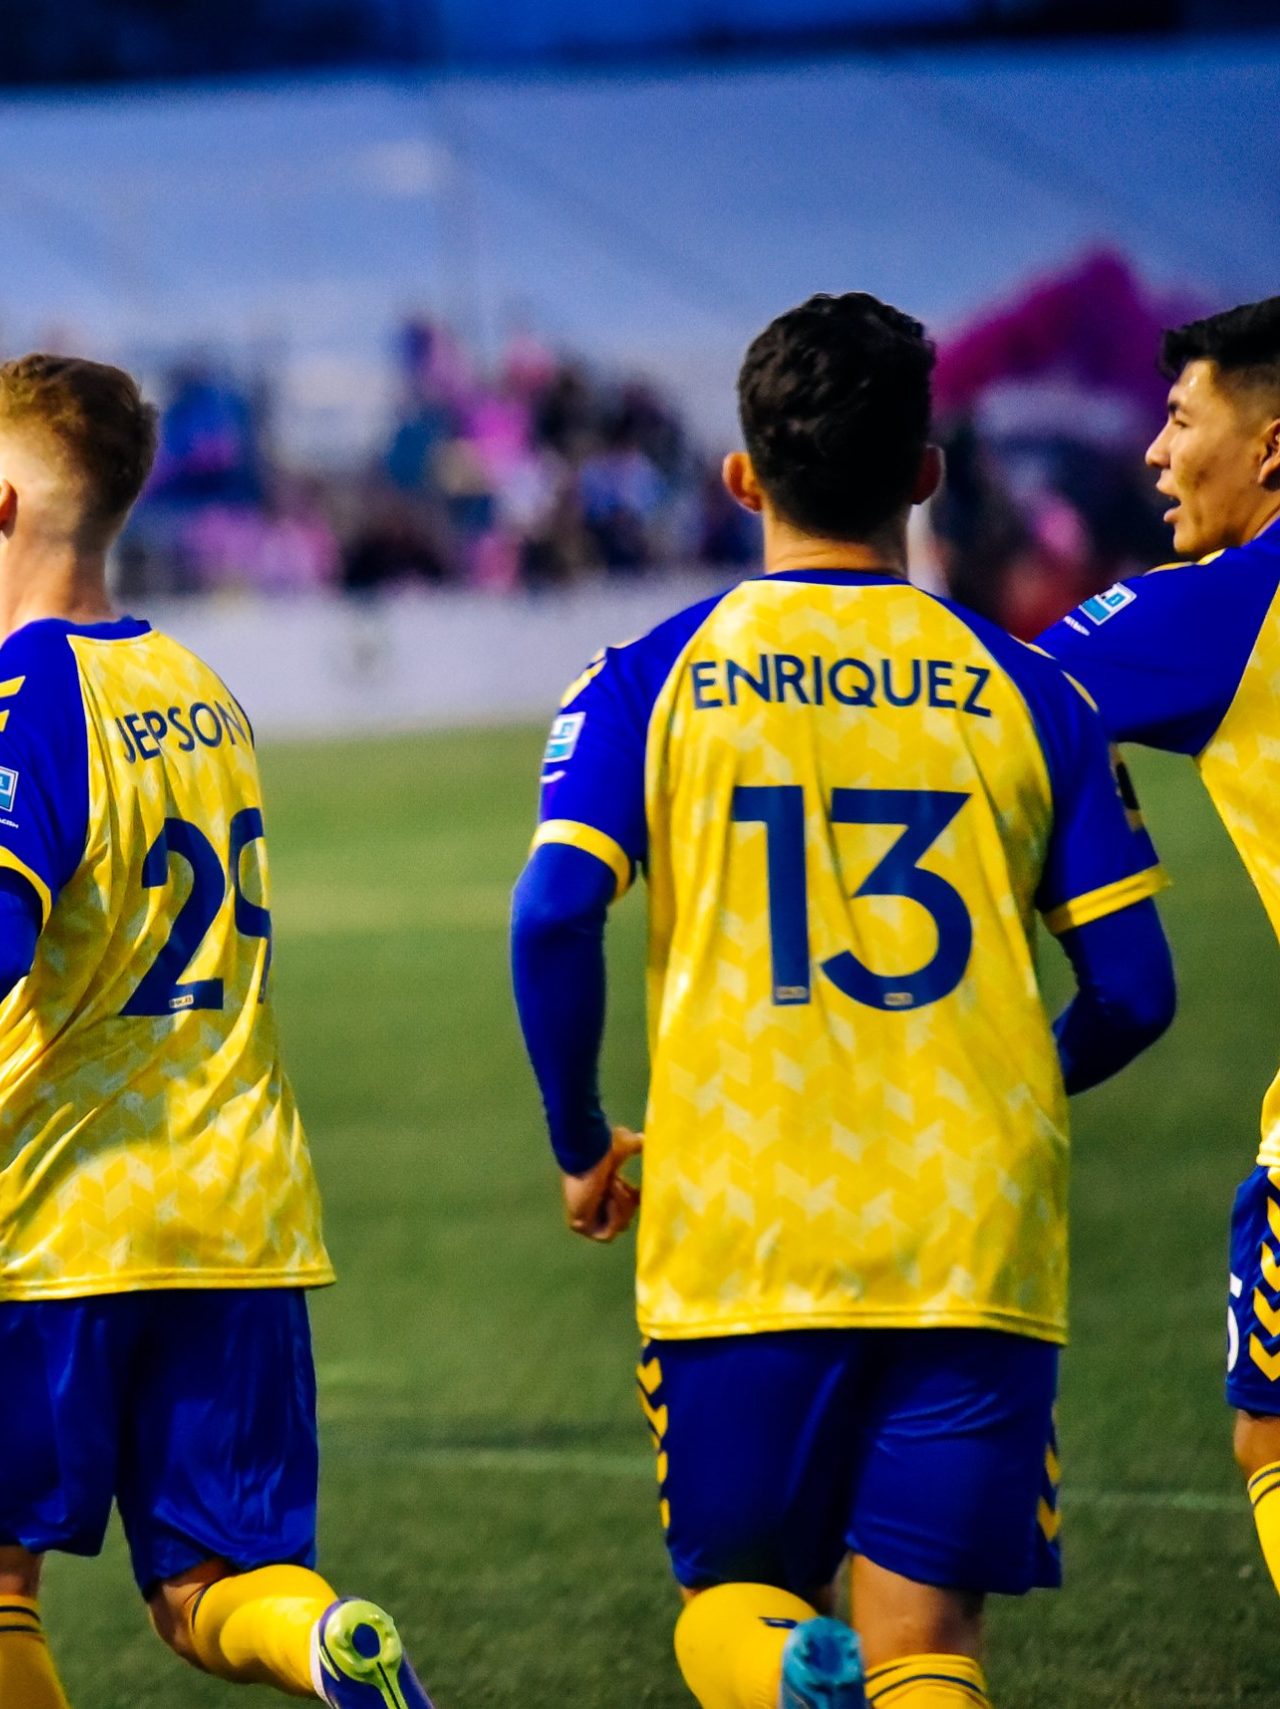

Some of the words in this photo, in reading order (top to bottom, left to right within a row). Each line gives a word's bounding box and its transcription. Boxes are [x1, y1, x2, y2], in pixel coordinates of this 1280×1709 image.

[690, 653, 993, 718] ENRIQUEZ
[114, 700, 249, 765] JEPSON
[731, 785, 974, 1012] 13
